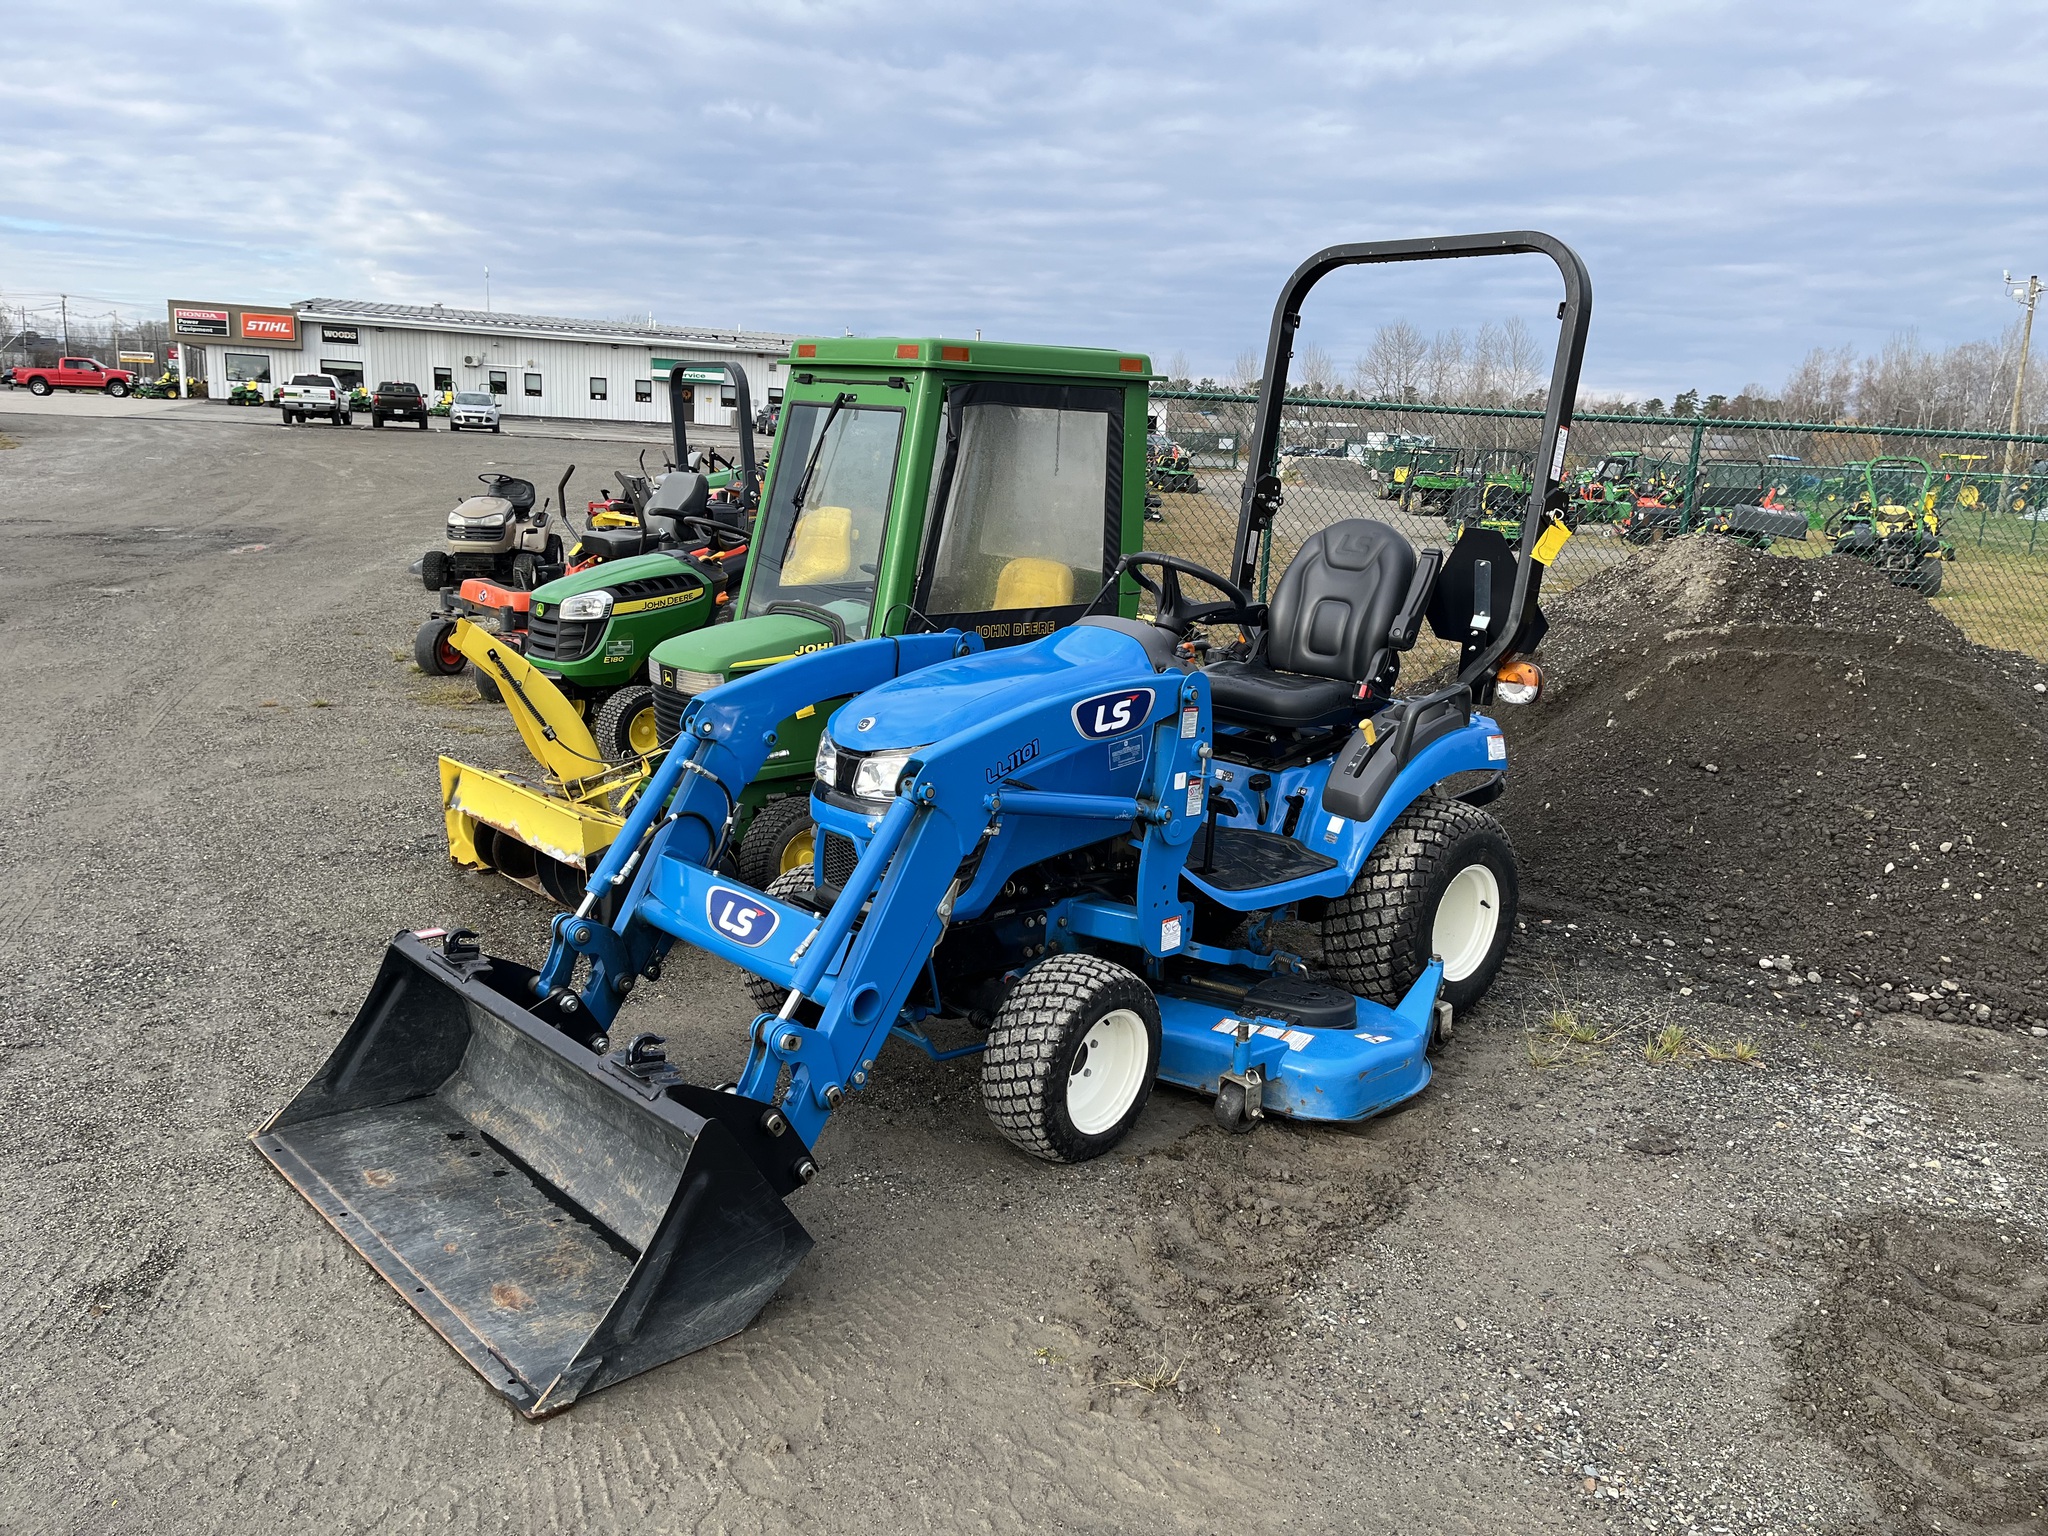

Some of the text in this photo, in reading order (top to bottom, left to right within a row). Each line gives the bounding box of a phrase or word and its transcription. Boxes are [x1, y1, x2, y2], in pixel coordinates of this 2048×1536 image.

[178, 311, 217, 319] HONDA
[246, 321, 291, 333] STIHL
[323, 330, 357, 339] WOODS
[642, 593, 694, 611] JOHN DEERE
[976, 620, 1056, 639] JOHN DEERE
[603, 656, 625, 664] E180
[1094, 699, 1132, 733] LS
[985, 738, 1040, 784] LL1101
[717, 900, 758, 938] LS
